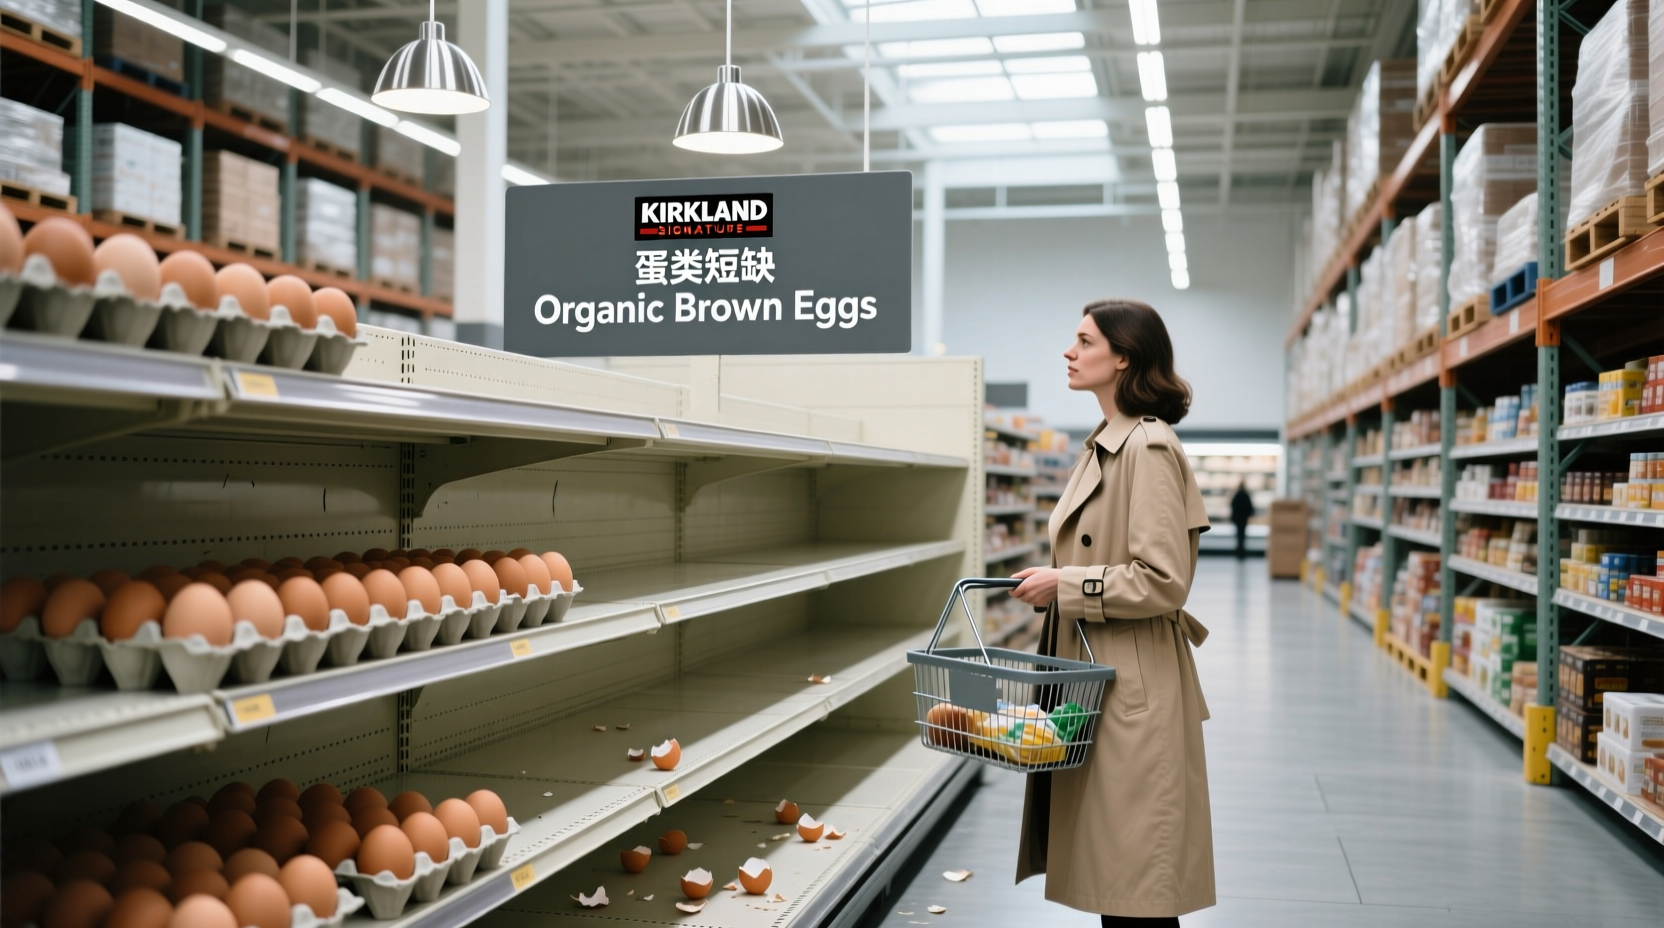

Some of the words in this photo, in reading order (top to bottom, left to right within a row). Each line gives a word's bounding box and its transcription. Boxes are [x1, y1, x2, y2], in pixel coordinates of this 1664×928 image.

[641, 199, 768, 224] KIRKLAND
[634, 246, 776, 286] 蛋类短缺
[534, 292, 665, 333] Organic
[674, 292, 783, 323] Brown
[794, 289, 879, 330] Eggs
